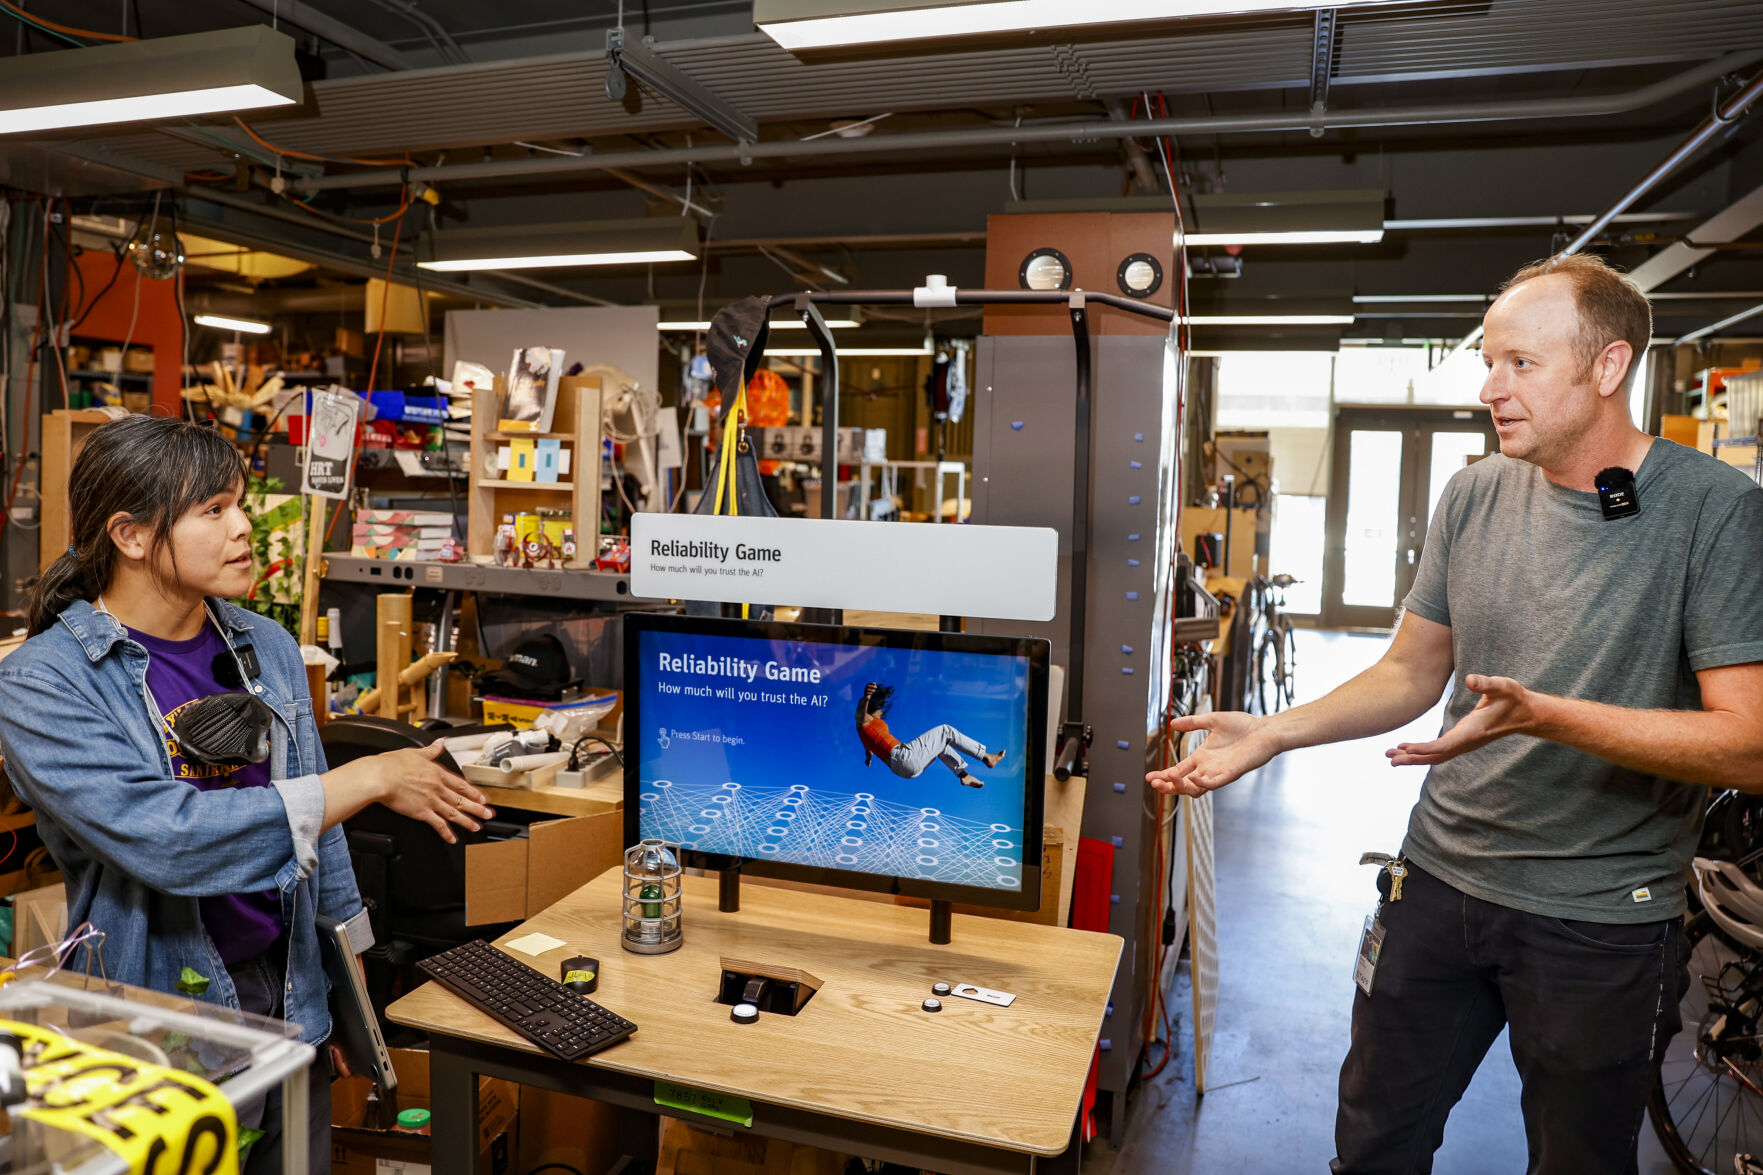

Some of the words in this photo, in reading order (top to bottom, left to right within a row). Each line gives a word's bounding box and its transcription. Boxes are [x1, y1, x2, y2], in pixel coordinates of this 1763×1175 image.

[310, 461, 333, 476] HRT
[651, 539, 729, 563] Reliability
[736, 543, 782, 561] Game
[650, 563, 666, 572] How
[668, 564, 688, 573] much
[690, 565, 702, 574] will
[704, 567, 717, 576] you
[720, 567, 736, 576] trust
[738, 568, 750, 576] the
[752, 568, 764, 577] AI?
[659, 652, 758, 683] Reliability
[765, 660, 821, 684] Game
[658, 681, 681, 695] How
[684, 685, 712, 697] much
[715, 687, 735, 700] will
[738, 691, 758, 703] you
[761, 691, 786, 704] trust
[790, 694, 807, 706] the
[811, 695, 828, 707] AI?
[671, 729, 691, 740] Press
[692, 731, 711, 743] Start
[712, 734, 721, 743] to
[722, 735, 745, 746] begin.
